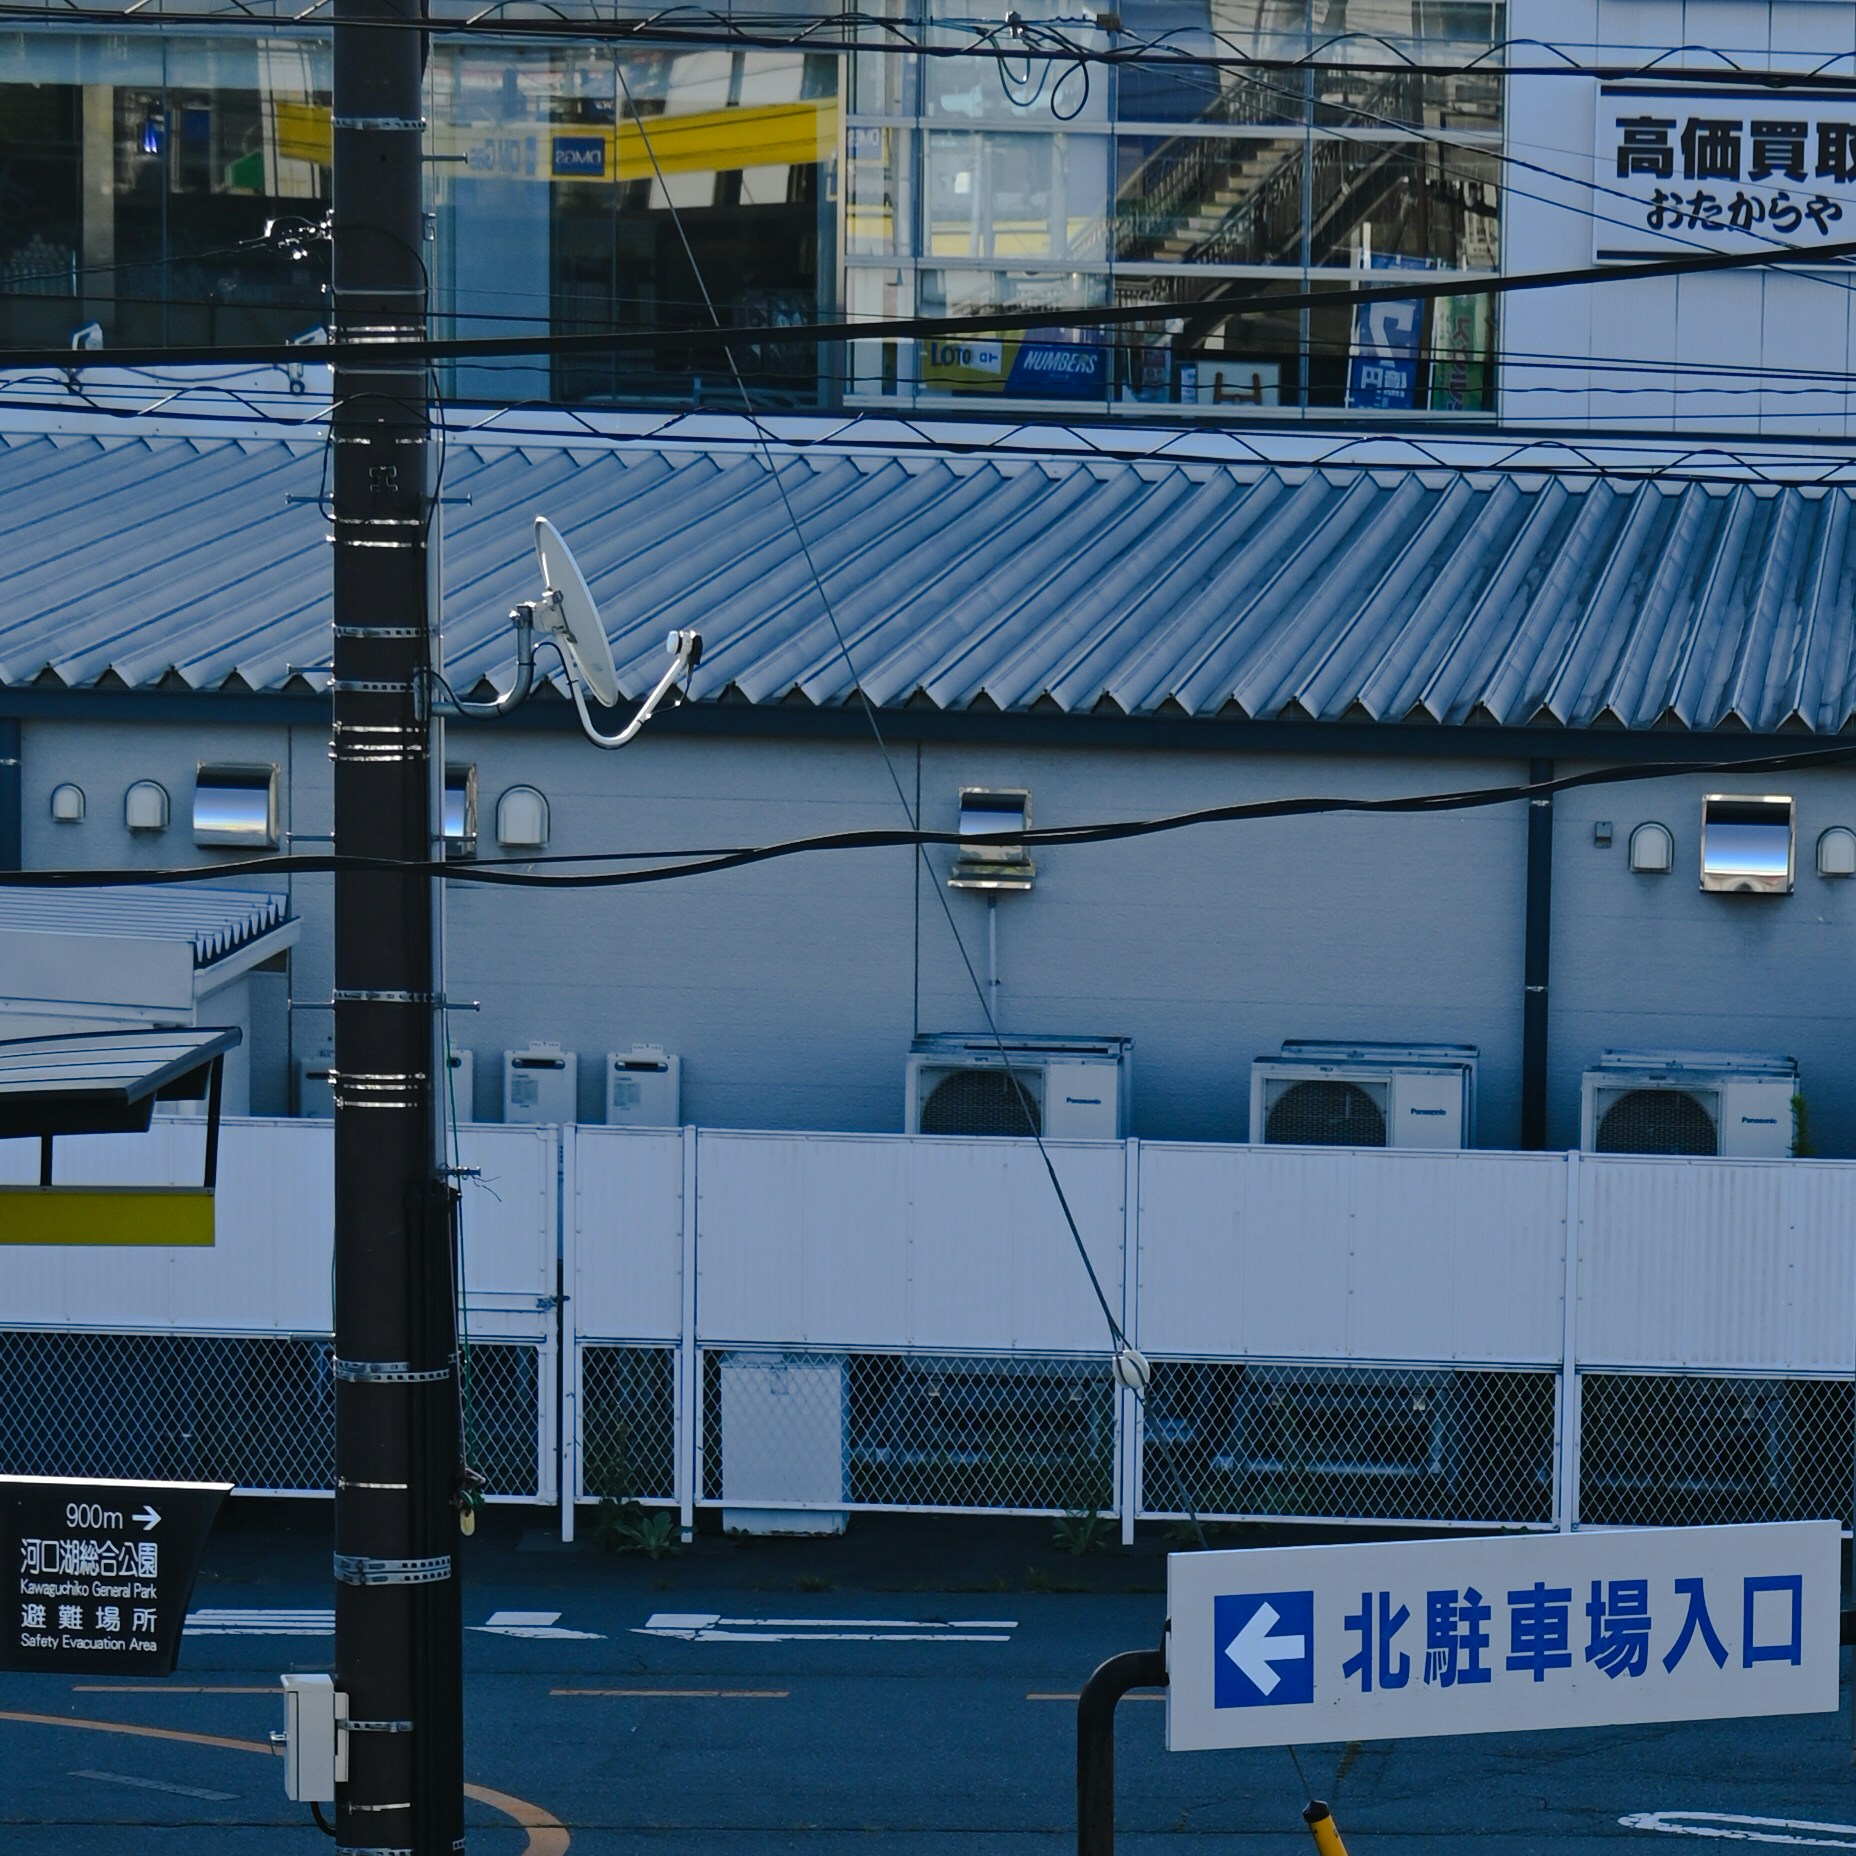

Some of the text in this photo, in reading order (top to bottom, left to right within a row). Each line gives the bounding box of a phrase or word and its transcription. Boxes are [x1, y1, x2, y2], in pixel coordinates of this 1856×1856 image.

[1647, 188, 1843, 236] おたからや
[931, 342, 972, 367] LOTO
[1024, 350, 1098, 374] NUMBERS
[66, 1502, 123, 1530] 900m
[20, 1538, 158, 1579] 河口湖総合公園
[20, 1578, 158, 1599] Kawaguchiko General Park
[20, 1603, 157, 1634] 避難場所
[20, 1632, 158, 1652] Safety Evacuation Area
[1341, 1574, 1803, 1693] 北駐車場入口
